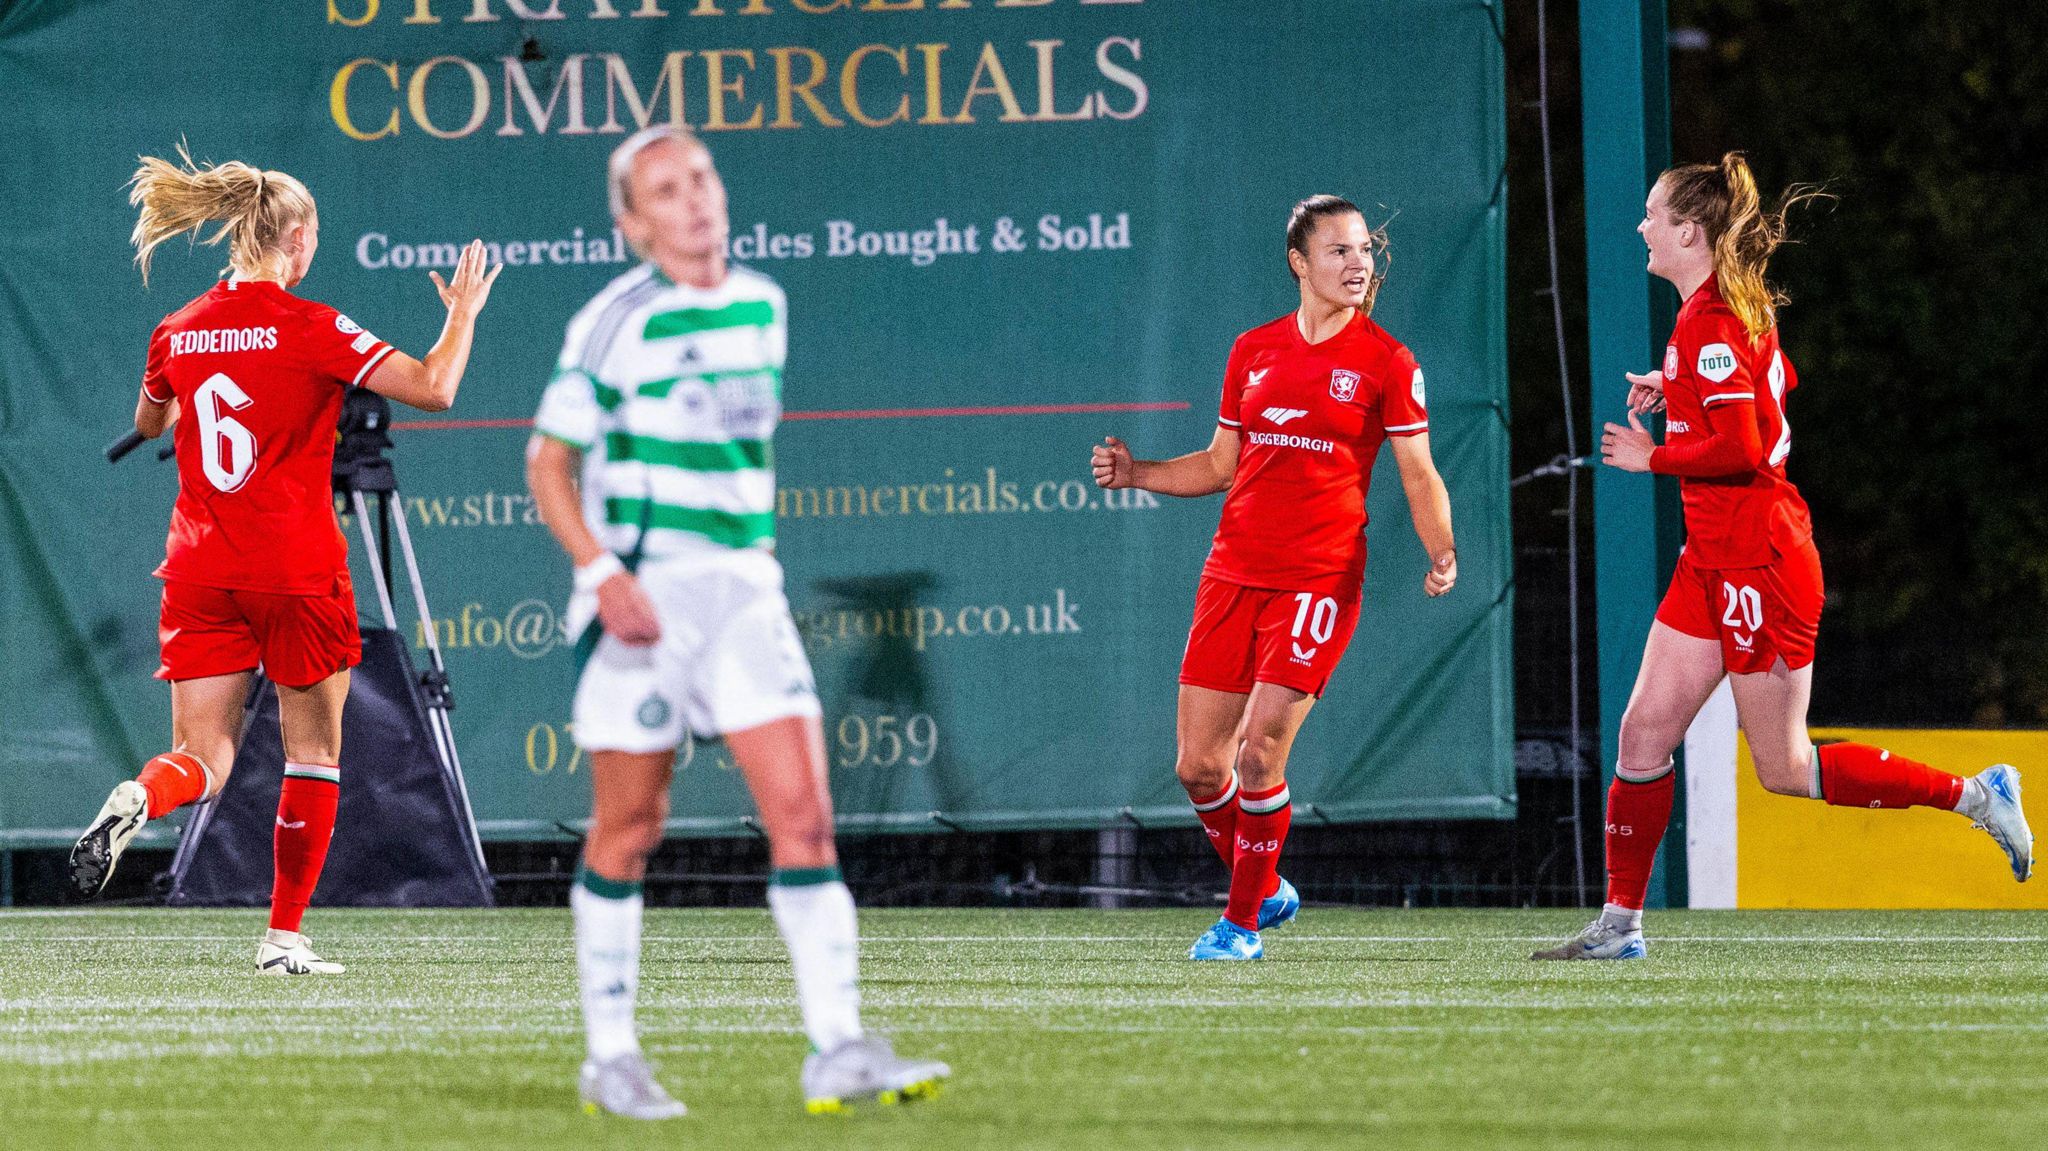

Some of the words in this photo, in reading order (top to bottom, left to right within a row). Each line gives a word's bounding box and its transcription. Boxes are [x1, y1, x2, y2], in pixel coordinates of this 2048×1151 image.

[329, 36, 1148, 141] COMMERCIALS
[826, 217, 981, 267] Bought
[991, 215, 1026, 253] &
[1038, 213, 1132, 251] Sold
[170, 326, 278, 358] PEDDEMORS
[1701, 355, 1732, 370] TOTO
[194, 372, 258, 493] 6
[1291, 592, 1339, 645] 10
[1722, 581, 1764, 632] 20
[838, 713, 938, 768] 959
[1237, 835, 1279, 852] 1965
